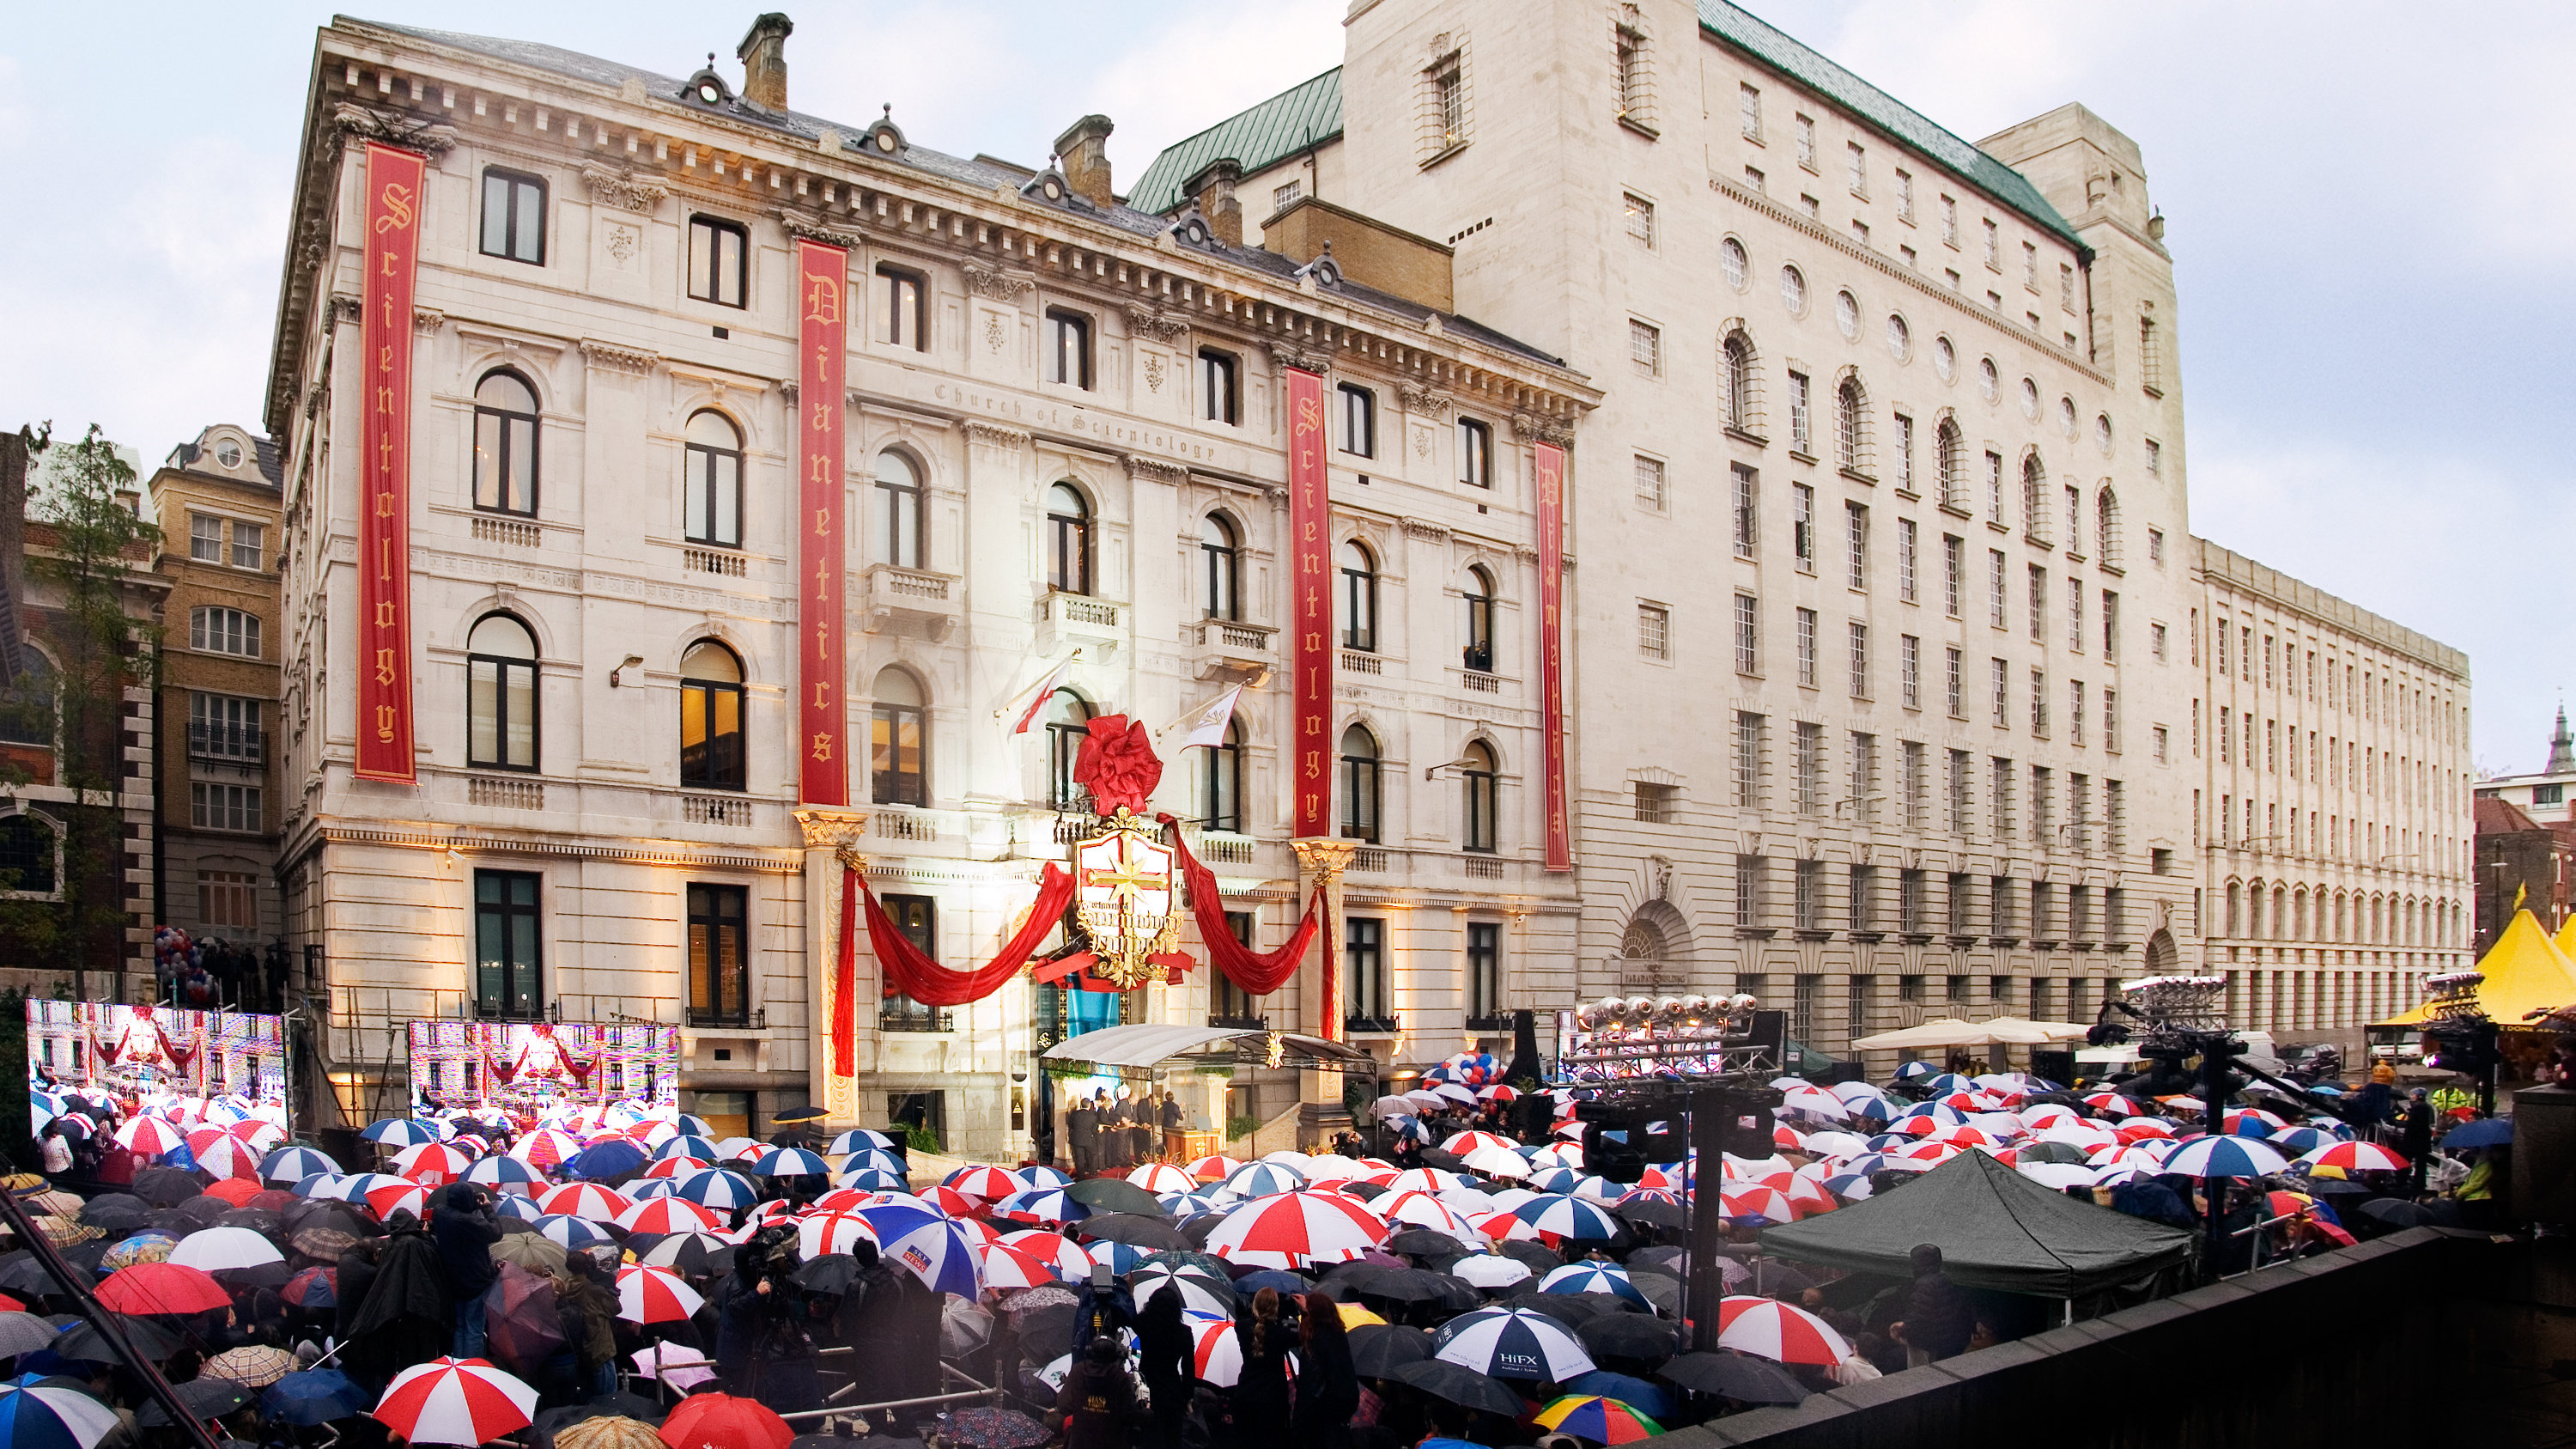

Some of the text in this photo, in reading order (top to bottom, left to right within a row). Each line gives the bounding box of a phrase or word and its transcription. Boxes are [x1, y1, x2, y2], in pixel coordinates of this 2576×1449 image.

[374, 182, 414, 744] Scientology
[805, 271, 841, 764] Dianetics
[934, 385, 1215, 461] Church of Scientology
[1296, 397, 1321, 823] Scientology
[904, 1253, 926, 1271] NEWS
[913, 1249, 927, 1262] SKY
